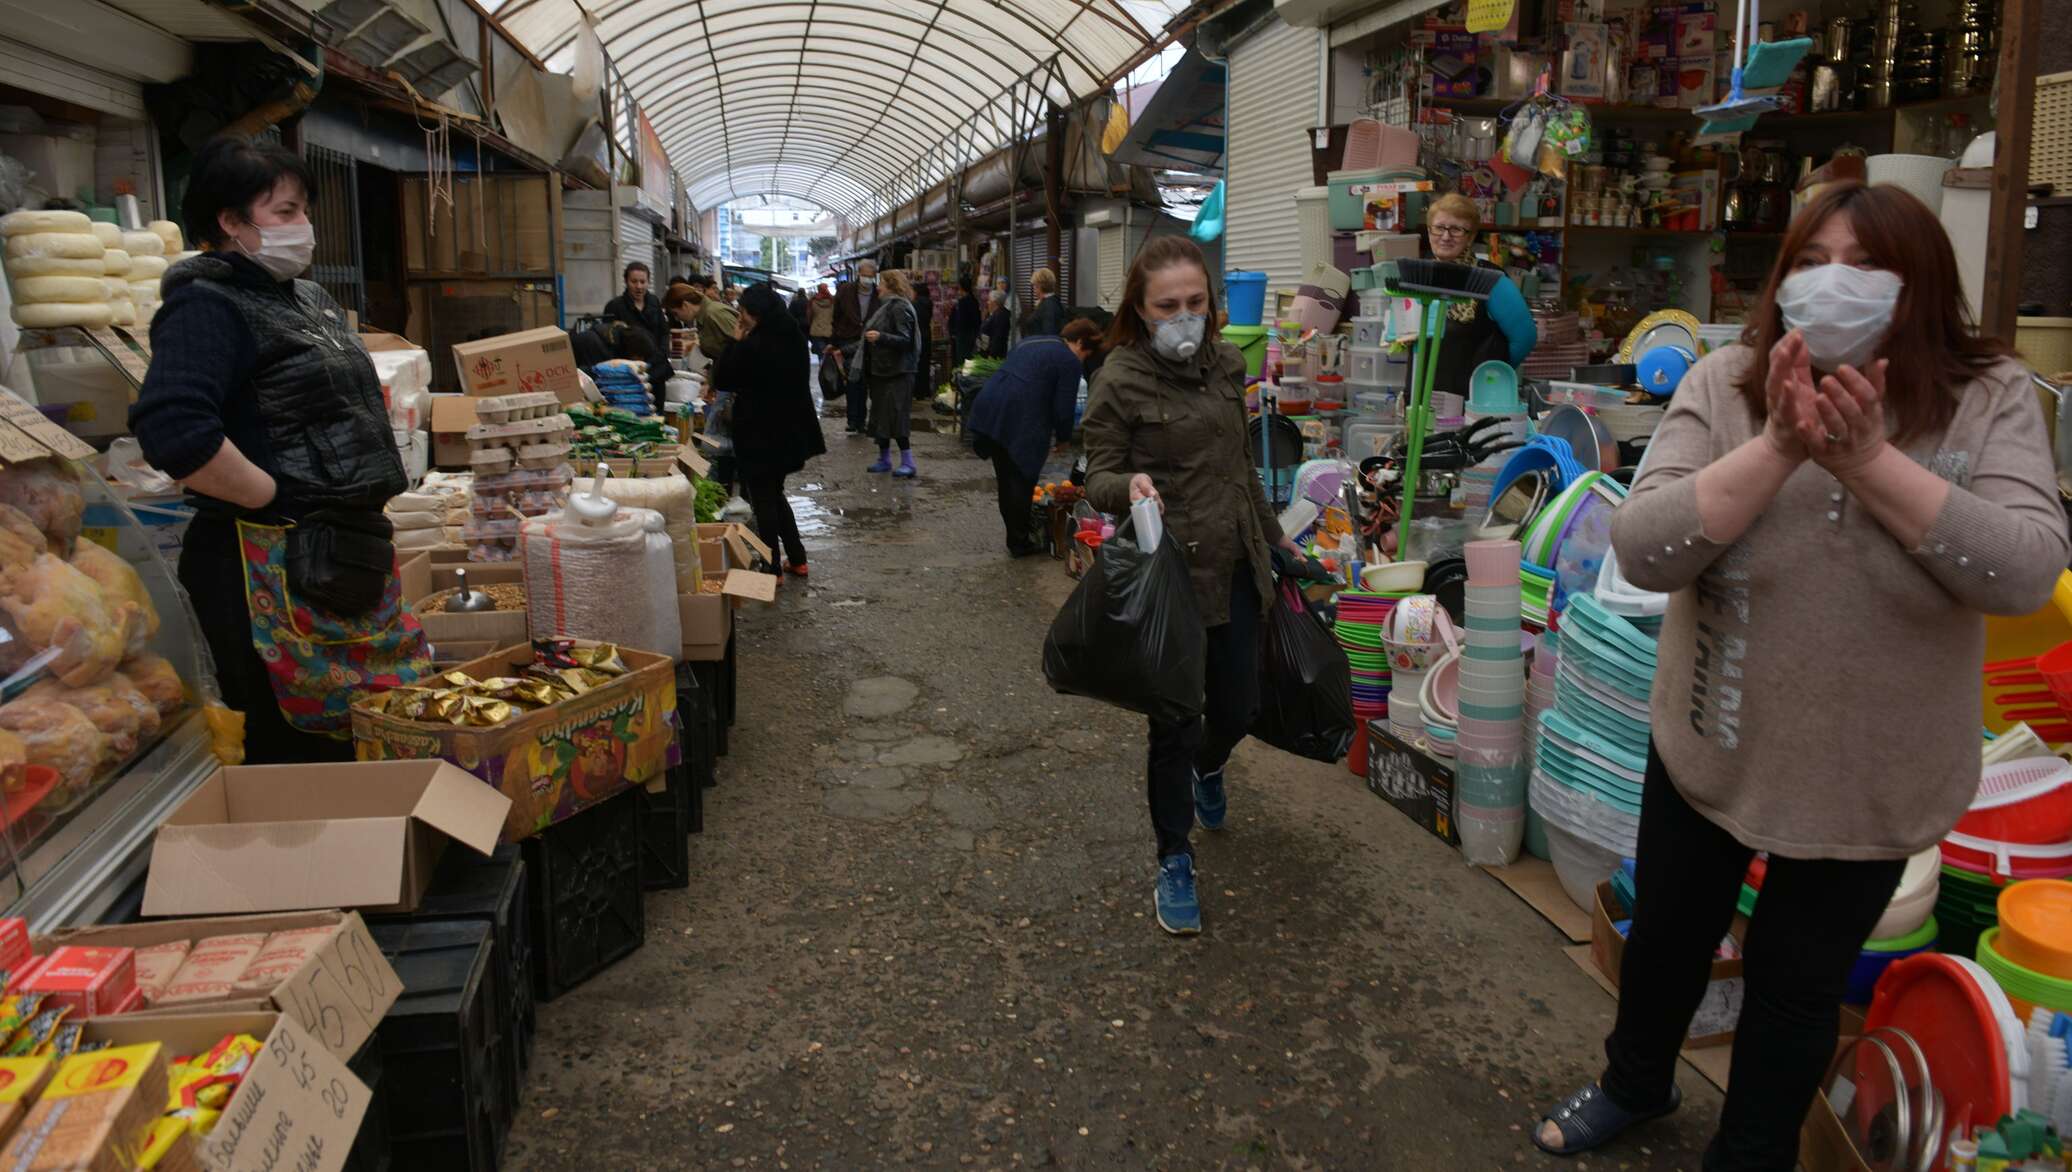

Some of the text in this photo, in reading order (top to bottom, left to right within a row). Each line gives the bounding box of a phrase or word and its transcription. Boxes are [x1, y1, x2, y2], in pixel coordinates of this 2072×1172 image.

[270, 1028, 296, 1068] 50
[291, 1051, 316, 1091] 45
[321, 1078, 348, 1118] 20
